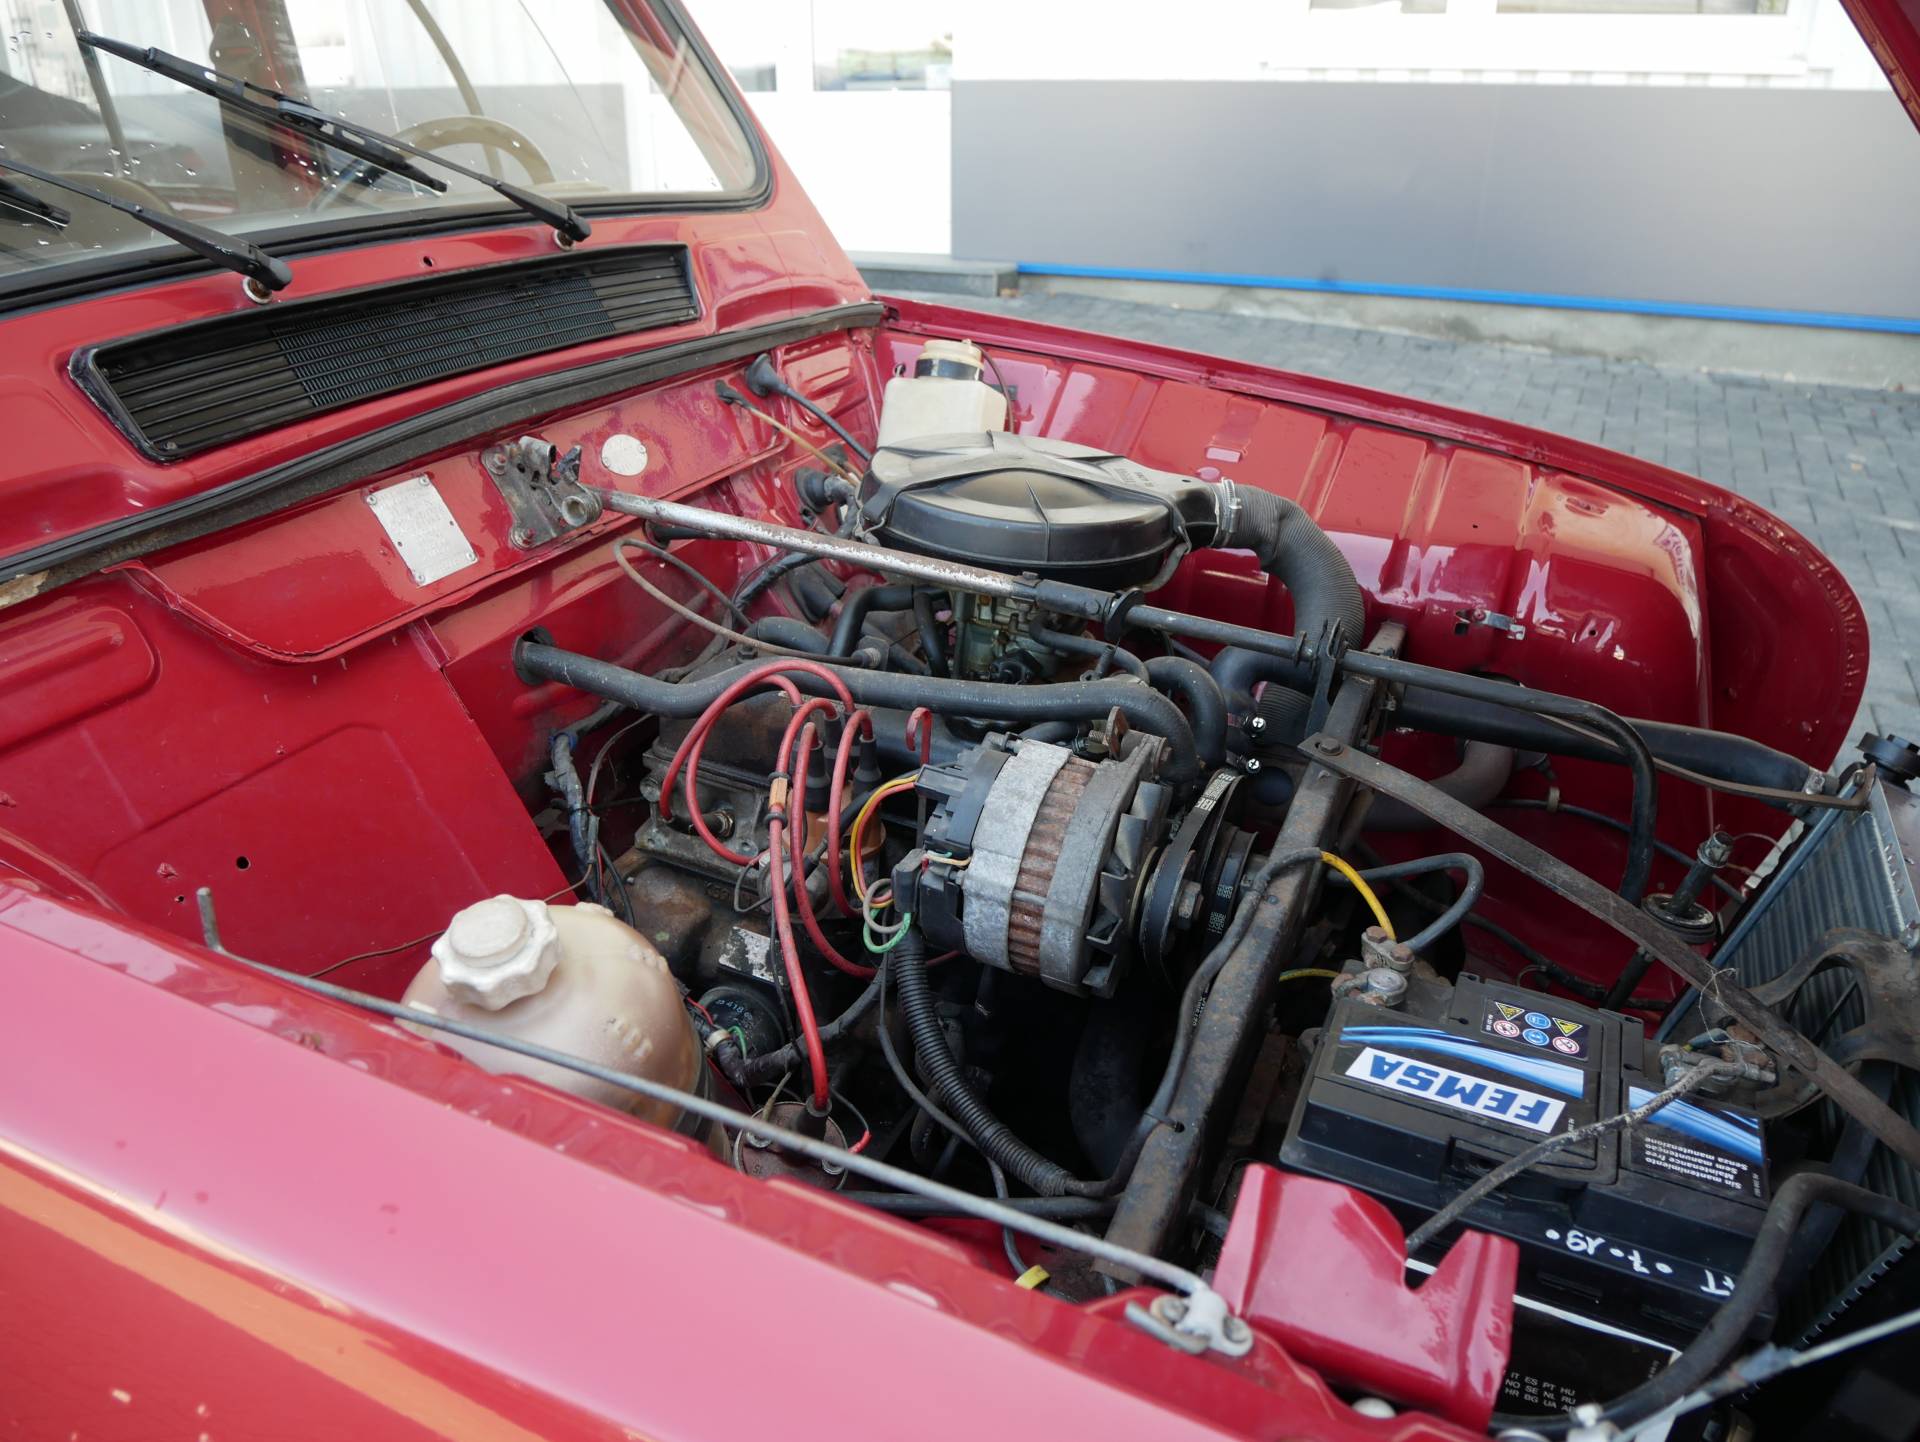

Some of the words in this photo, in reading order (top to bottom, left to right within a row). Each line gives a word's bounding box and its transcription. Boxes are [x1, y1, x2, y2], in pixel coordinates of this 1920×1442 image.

[1369, 1054, 1551, 1125] FEMSA
[1645, 1137, 1715, 1160] manutenzione
[1645, 1150, 1666, 1161] free
[1645, 1157, 1722, 1183] mantenimiento
[1668, 1157, 1735, 1180] Maintenance
[1715, 1162, 1738, 1175] Sem
[1717, 1157, 1748, 1171] Senza
[1724, 1179, 1742, 1190] Sin
[1505, 1379, 1520, 1388] NO
[1525, 1385, 1538, 1394] SE
[1543, 1391, 1555, 1400] NL
[1561, 1396, 1576, 1405] RU
[1524, 1376, 1538, 1386] ES
[1542, 1382, 1556, 1391] PT
[1560, 1387, 1575, 1397] HU
[1505, 1387, 1519, 1397] HR
[1524, 1394, 1538, 1403] BG
[1544, 1400, 1557, 1409] UA
